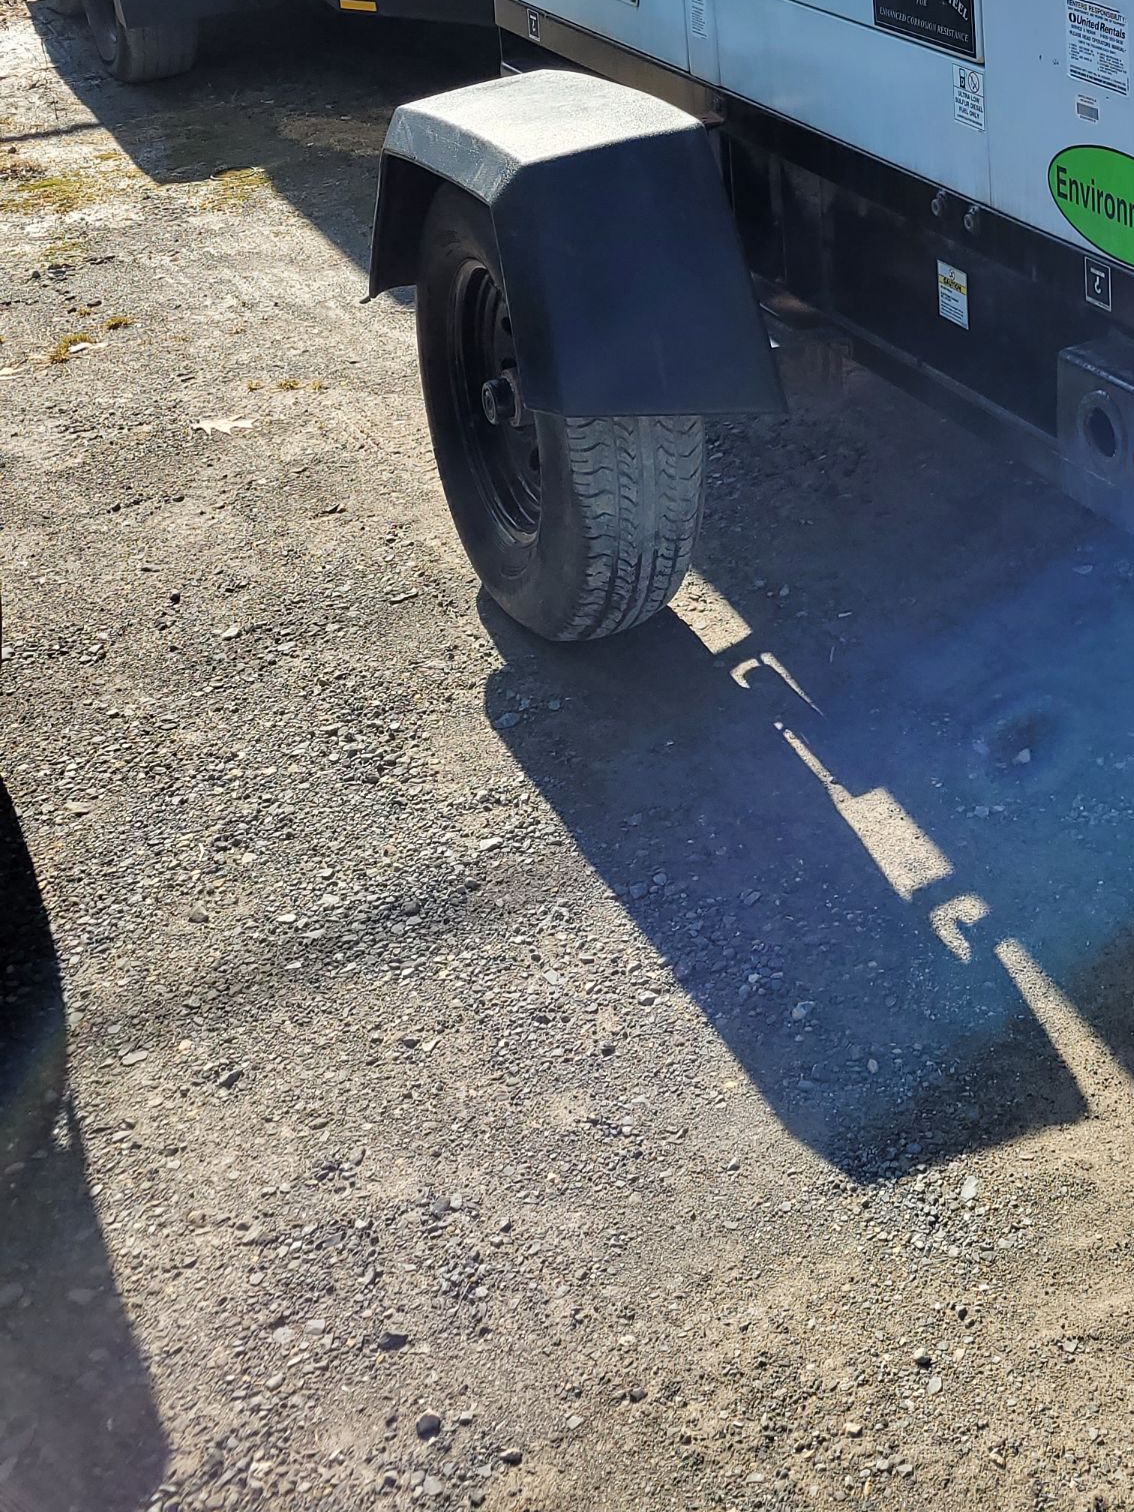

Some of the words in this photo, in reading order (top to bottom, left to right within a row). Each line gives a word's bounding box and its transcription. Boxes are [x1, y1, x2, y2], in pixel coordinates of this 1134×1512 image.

[880, 7, 906, 22] ENHANCED
[906, 15, 937, 32] CORROSION
[937, 24, 969, 43] RESISTANCE
[1076, 14, 1100, 31] United
[1100, 22, 1126, 40] Rentals
